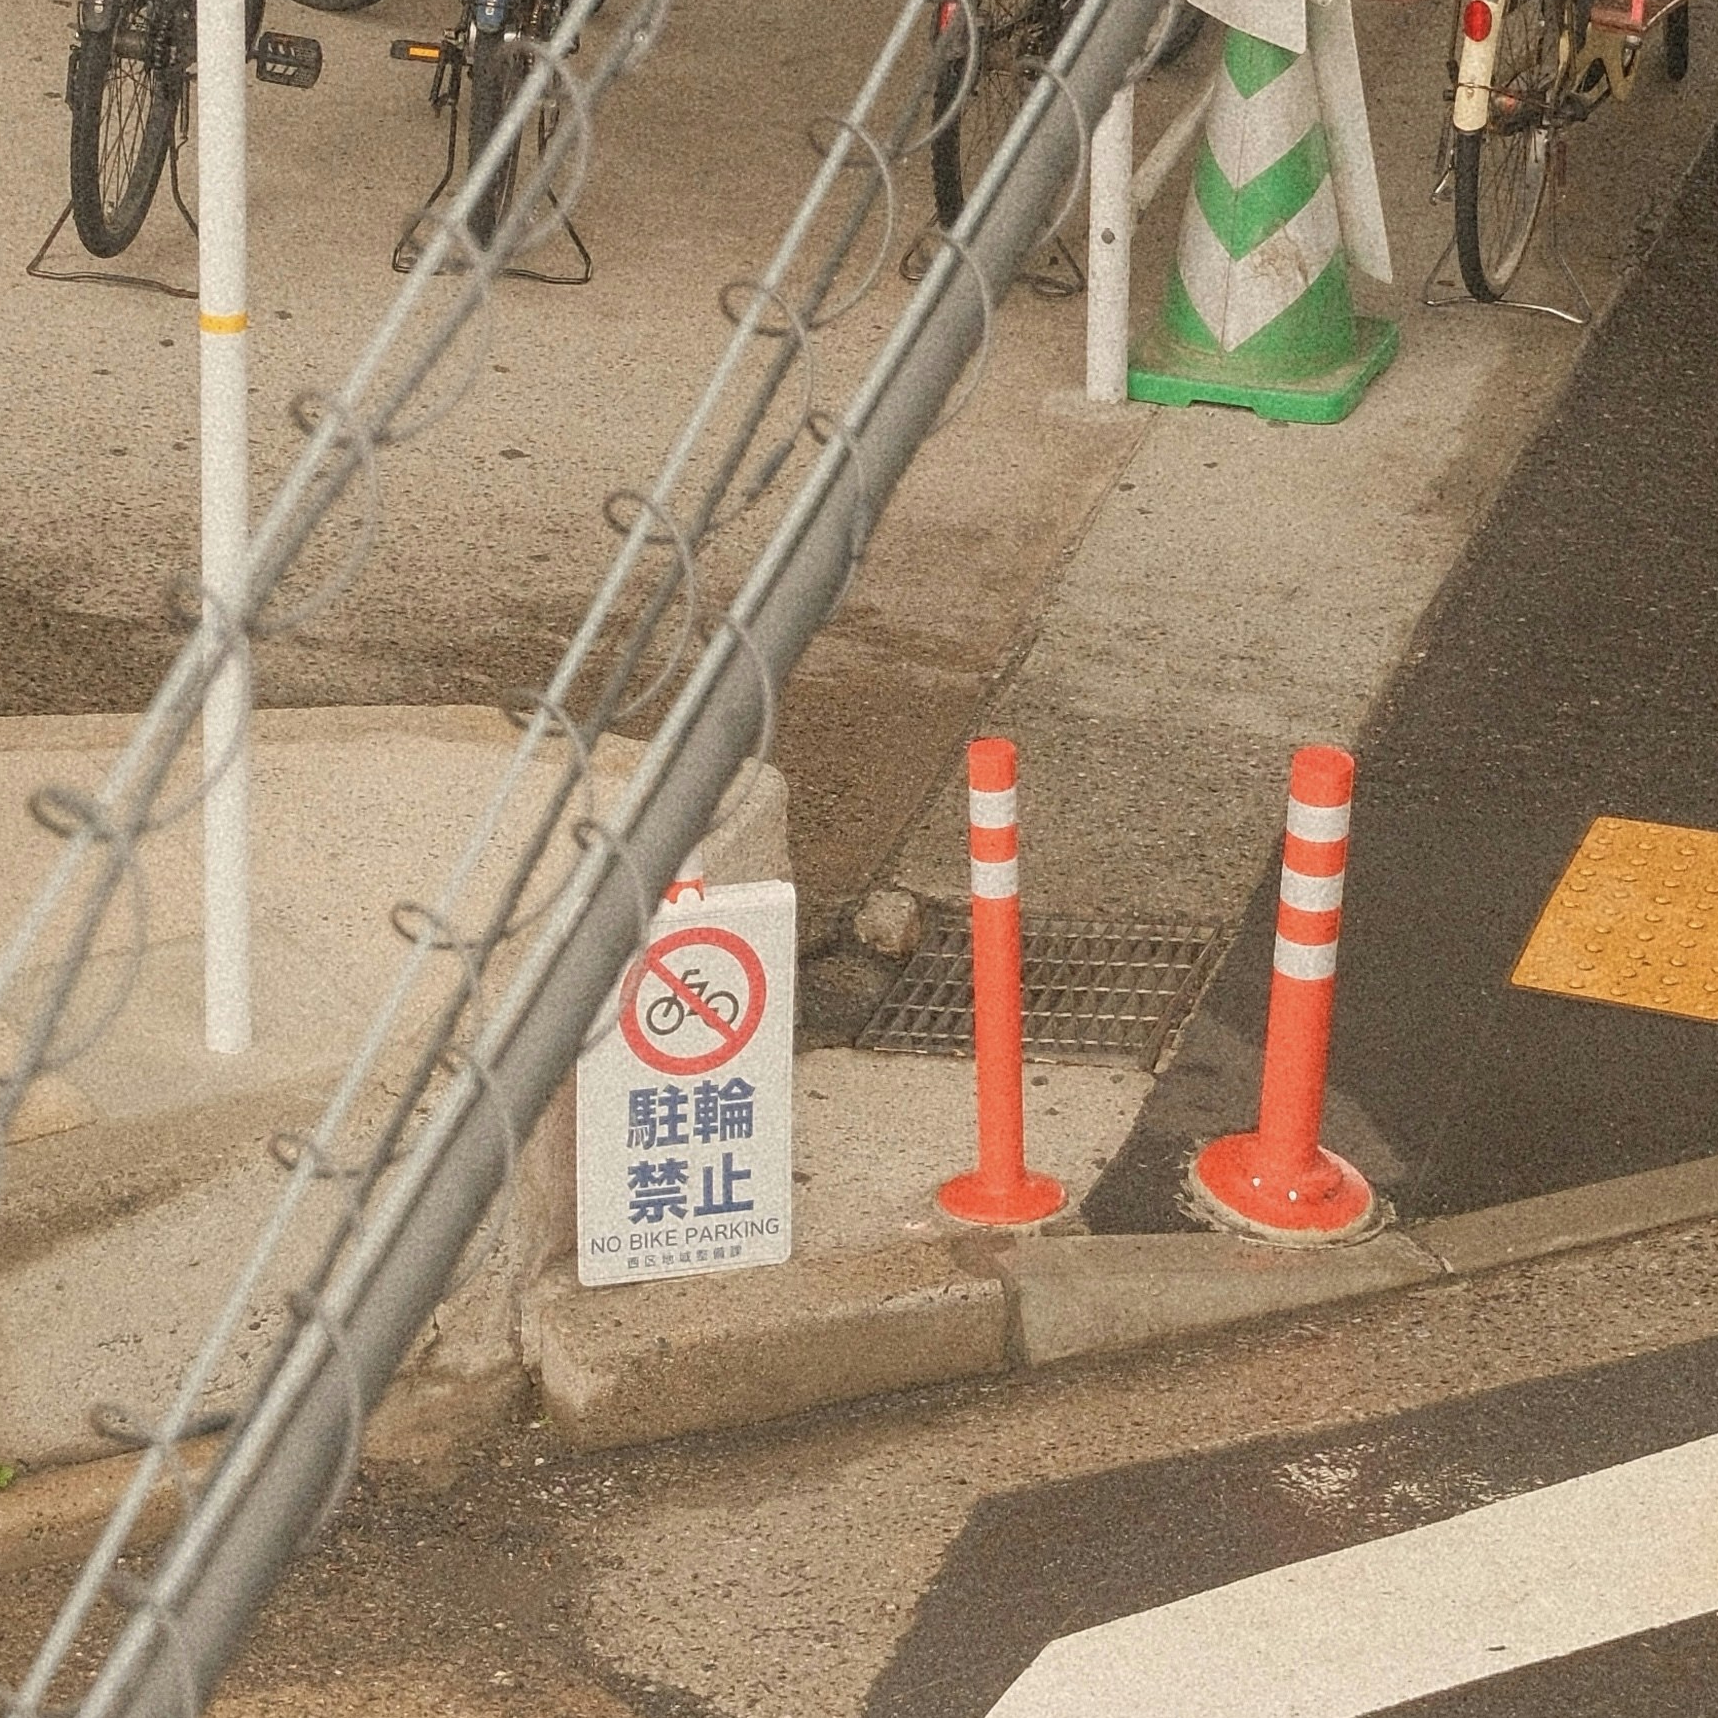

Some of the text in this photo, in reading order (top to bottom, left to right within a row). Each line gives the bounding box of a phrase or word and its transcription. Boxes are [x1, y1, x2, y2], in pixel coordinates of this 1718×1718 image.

[626, 1077, 756, 1150] 駐輪
[627, 1152, 754, 1225] 禁止
[590, 1218, 781, 1256] NO BIKE PARKING
[627, 1244, 743, 1270] 西区地域整備課
